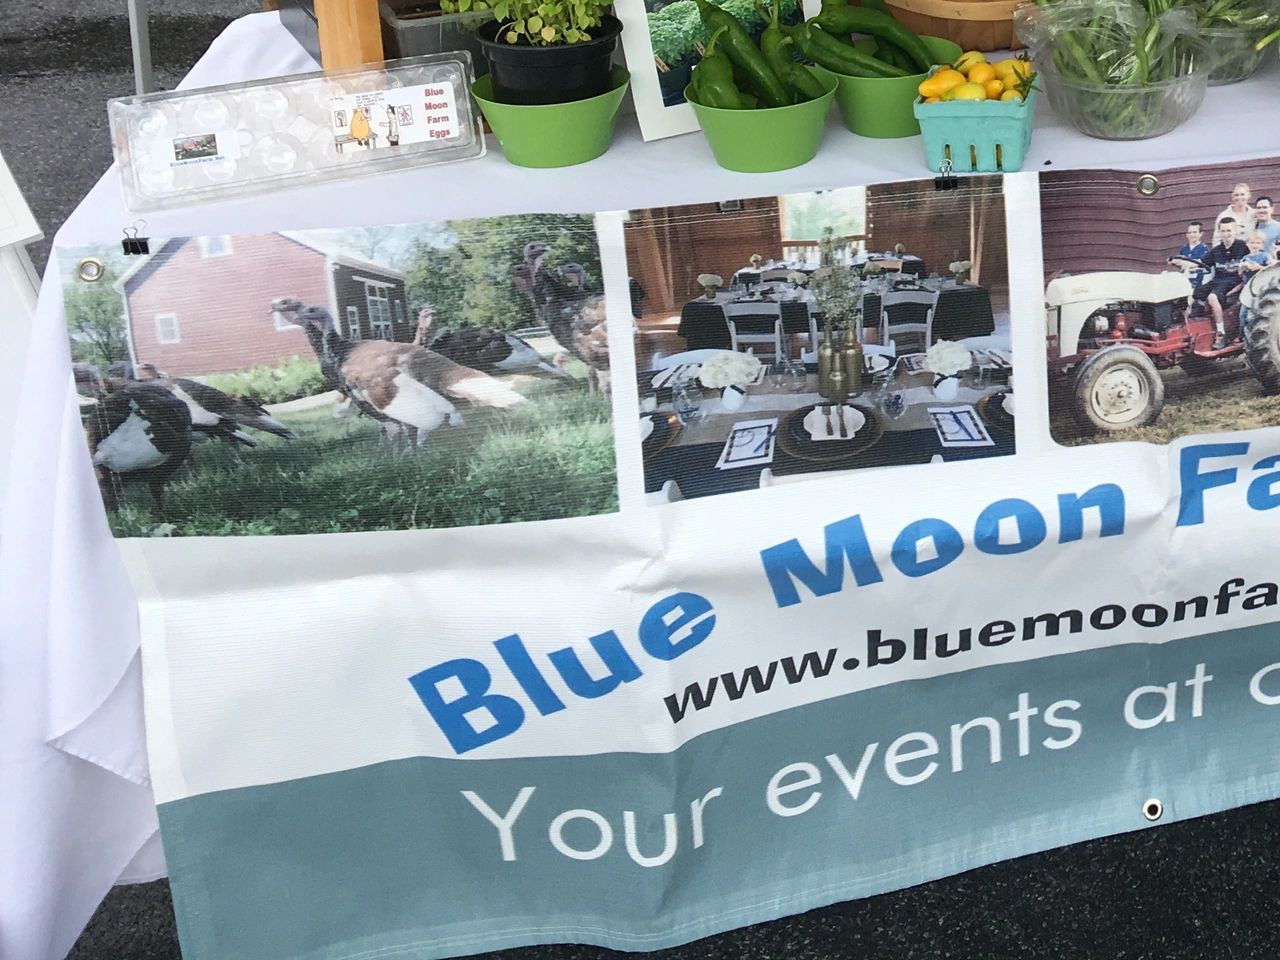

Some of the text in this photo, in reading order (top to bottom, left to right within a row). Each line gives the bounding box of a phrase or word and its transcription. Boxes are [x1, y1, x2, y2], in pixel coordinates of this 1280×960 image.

[424, 87, 445, 97] Blue
[424, 101, 448, 111] Moon
[427, 115, 449, 124] Farm
[429, 128, 451, 139] Eggs
[408, 591, 717, 756] Blue
[760, 481, 1125, 608] Moon
[460, 785, 723, 869] Your
[765, 692, 1085, 818] events
[1123, 661, 1214, 731] at
